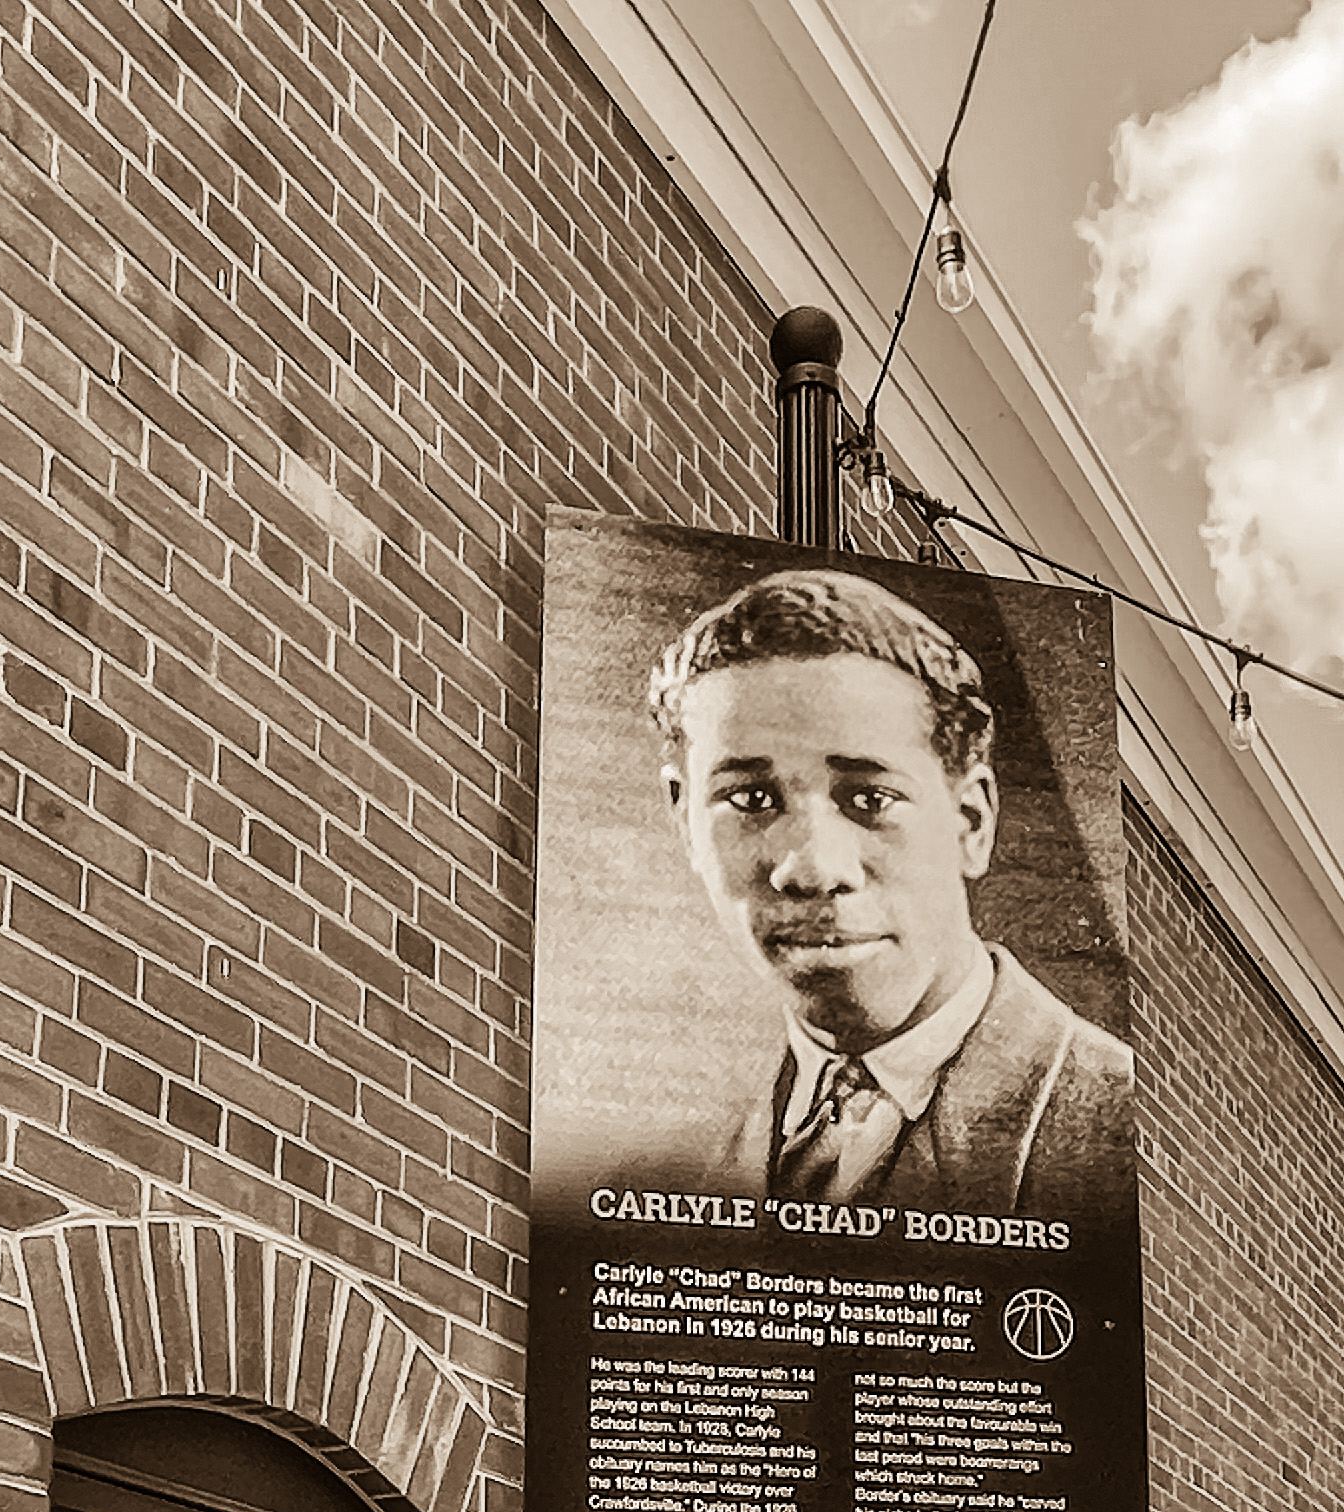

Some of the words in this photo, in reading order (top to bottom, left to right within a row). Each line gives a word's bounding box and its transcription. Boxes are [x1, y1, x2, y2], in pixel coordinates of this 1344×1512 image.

[590, 1189, 755, 1227] CARLYLE
[905, 1211, 1069, 1249] BORDERS
[595, 1263, 664, 1287] Carlyle
[747, 1273, 823, 1294] Borders
[829, 1277, 905, 1299] became
[909, 1283, 939, 1301] the
[943, 1285, 982, 1305] first
[593, 1287, 665, 1308] African
[670, 1291, 764, 1314] American
[769, 1299, 789, 1315] to
[794, 1300, 835, 1323] play
[840, 1301, 937, 1325] basketball
[943, 1309, 971, 1326] for
[593, 1311, 681, 1333] Lebanon
[687, 1317, 703, 1335] in
[711, 1319, 756, 1337] 1926
[761, 1321, 825, 1346] during
[831, 1325, 859, 1343] his
[865, 1329, 927, 1347] senior
[928, 1335, 975, 1353] year.
